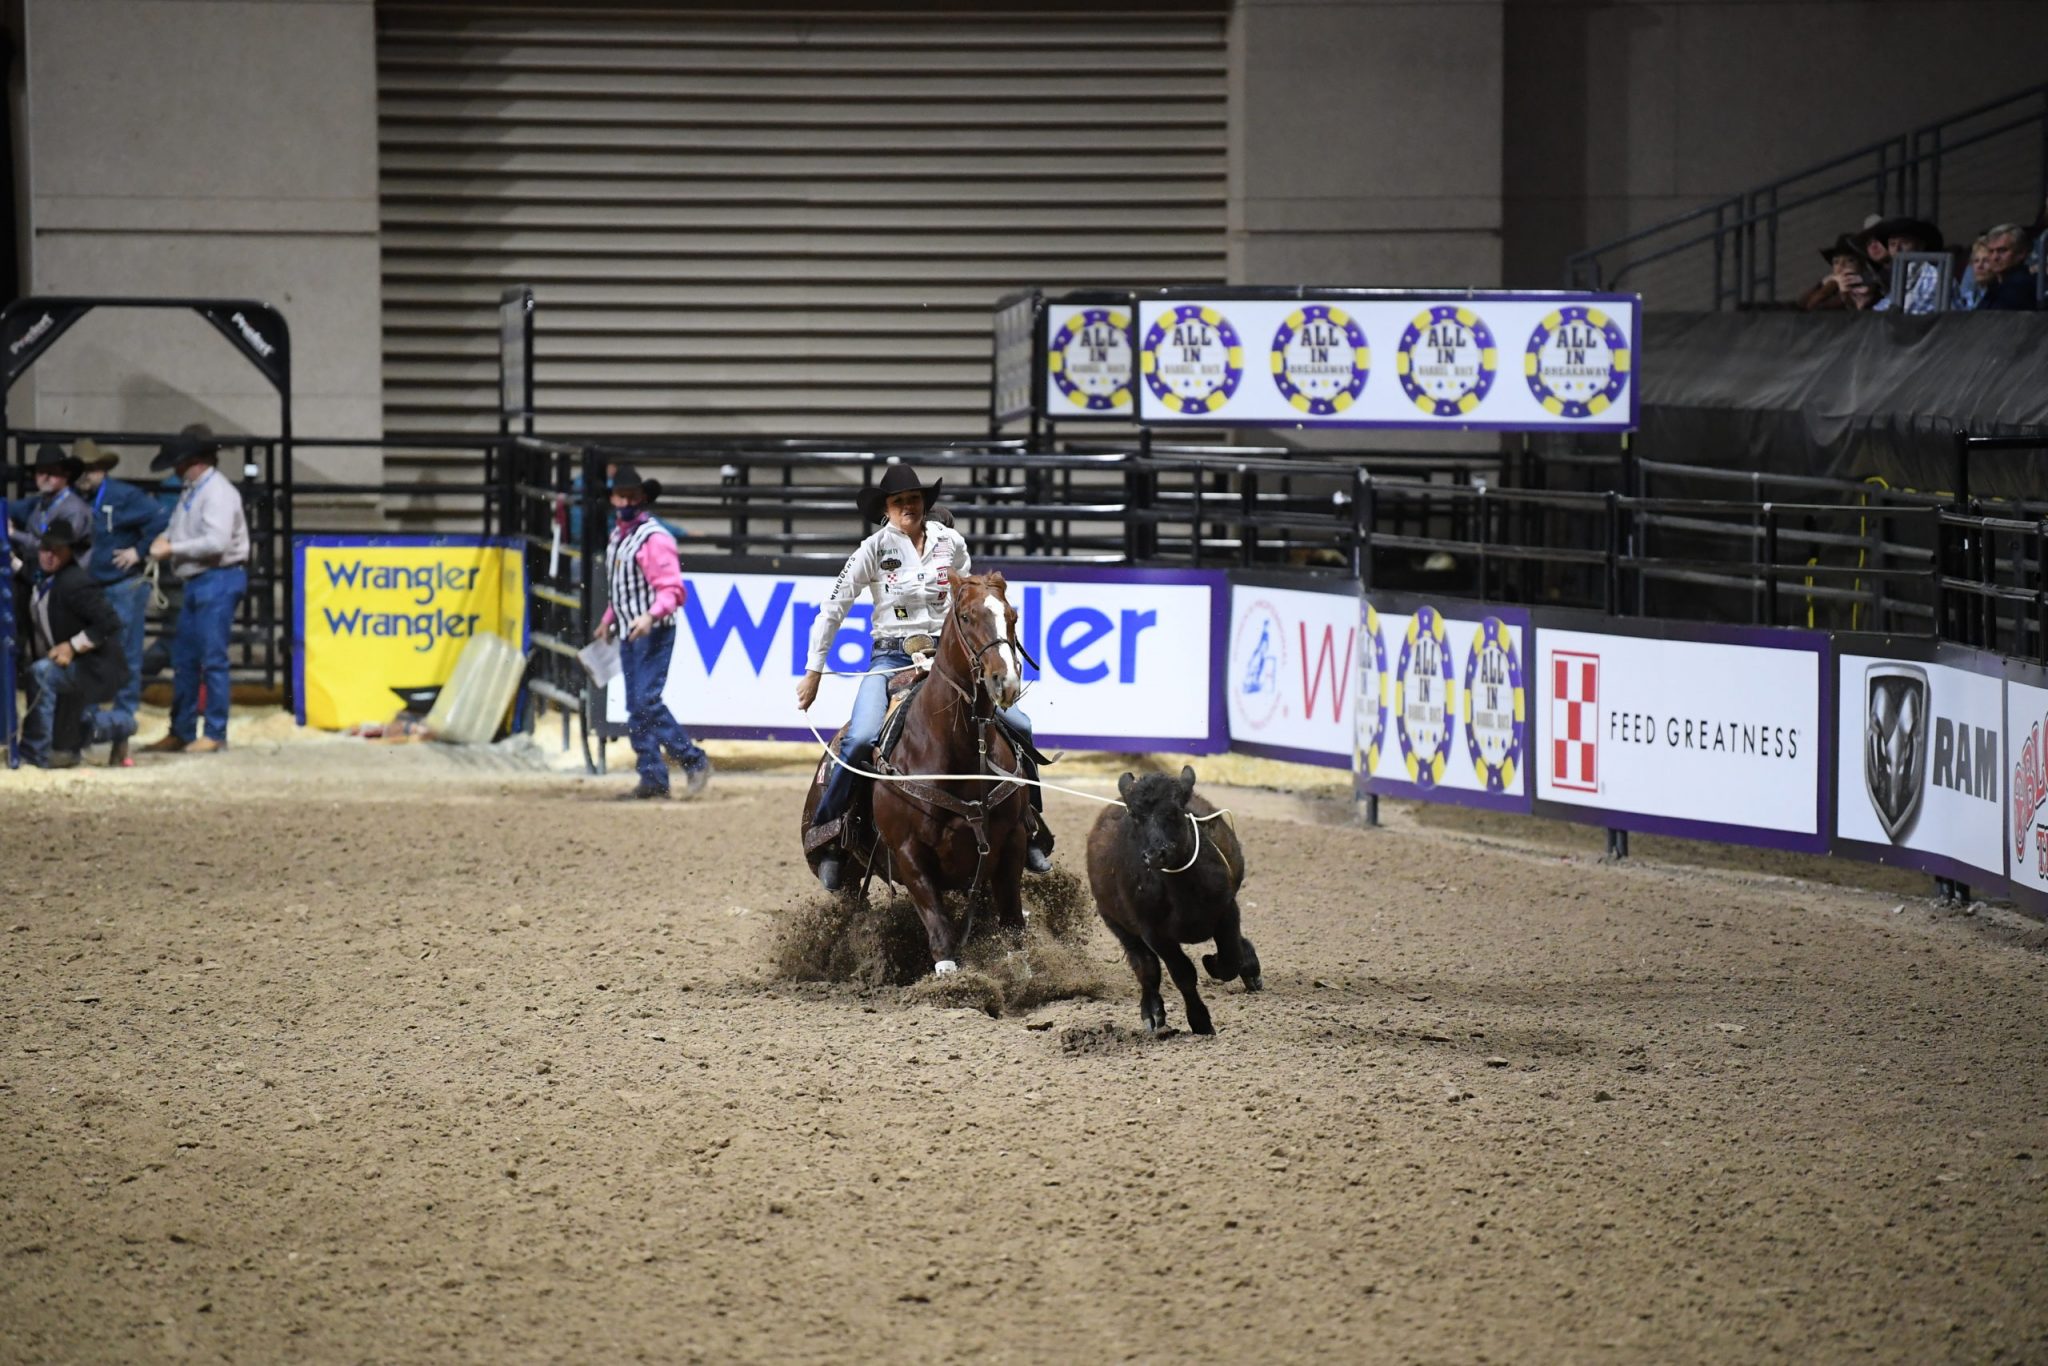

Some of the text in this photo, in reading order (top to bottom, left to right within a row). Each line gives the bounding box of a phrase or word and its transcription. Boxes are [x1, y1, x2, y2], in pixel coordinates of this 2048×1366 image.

[1080, 327, 1118, 347] ALL
[1173, 325, 1212, 346] ALL
[1300, 325, 1339, 346] ALL
[1427, 326, 1466, 347] ALL
[1556, 326, 1597, 348] ALL
[1090, 347, 1107, 362] IN
[1183, 347, 1200, 362] IN
[1311, 347, 1328, 363] IN
[1437, 348, 1455, 364] IN
[1566, 349, 1585, 365] IN
[323, 560, 480, 605] Wrangler
[323, 608, 480, 652] Wrangler
[682, 581, 1157, 685] Wraler
[1414, 640, 1437, 676] ALL
[1481, 649, 1504, 685] ALL
[1419, 678, 1430, 702] IN
[1487, 686, 1498, 710] IN
[1611, 711, 1797, 759] FEED GREATNESS
[1932, 716, 1998, 803] RAM
